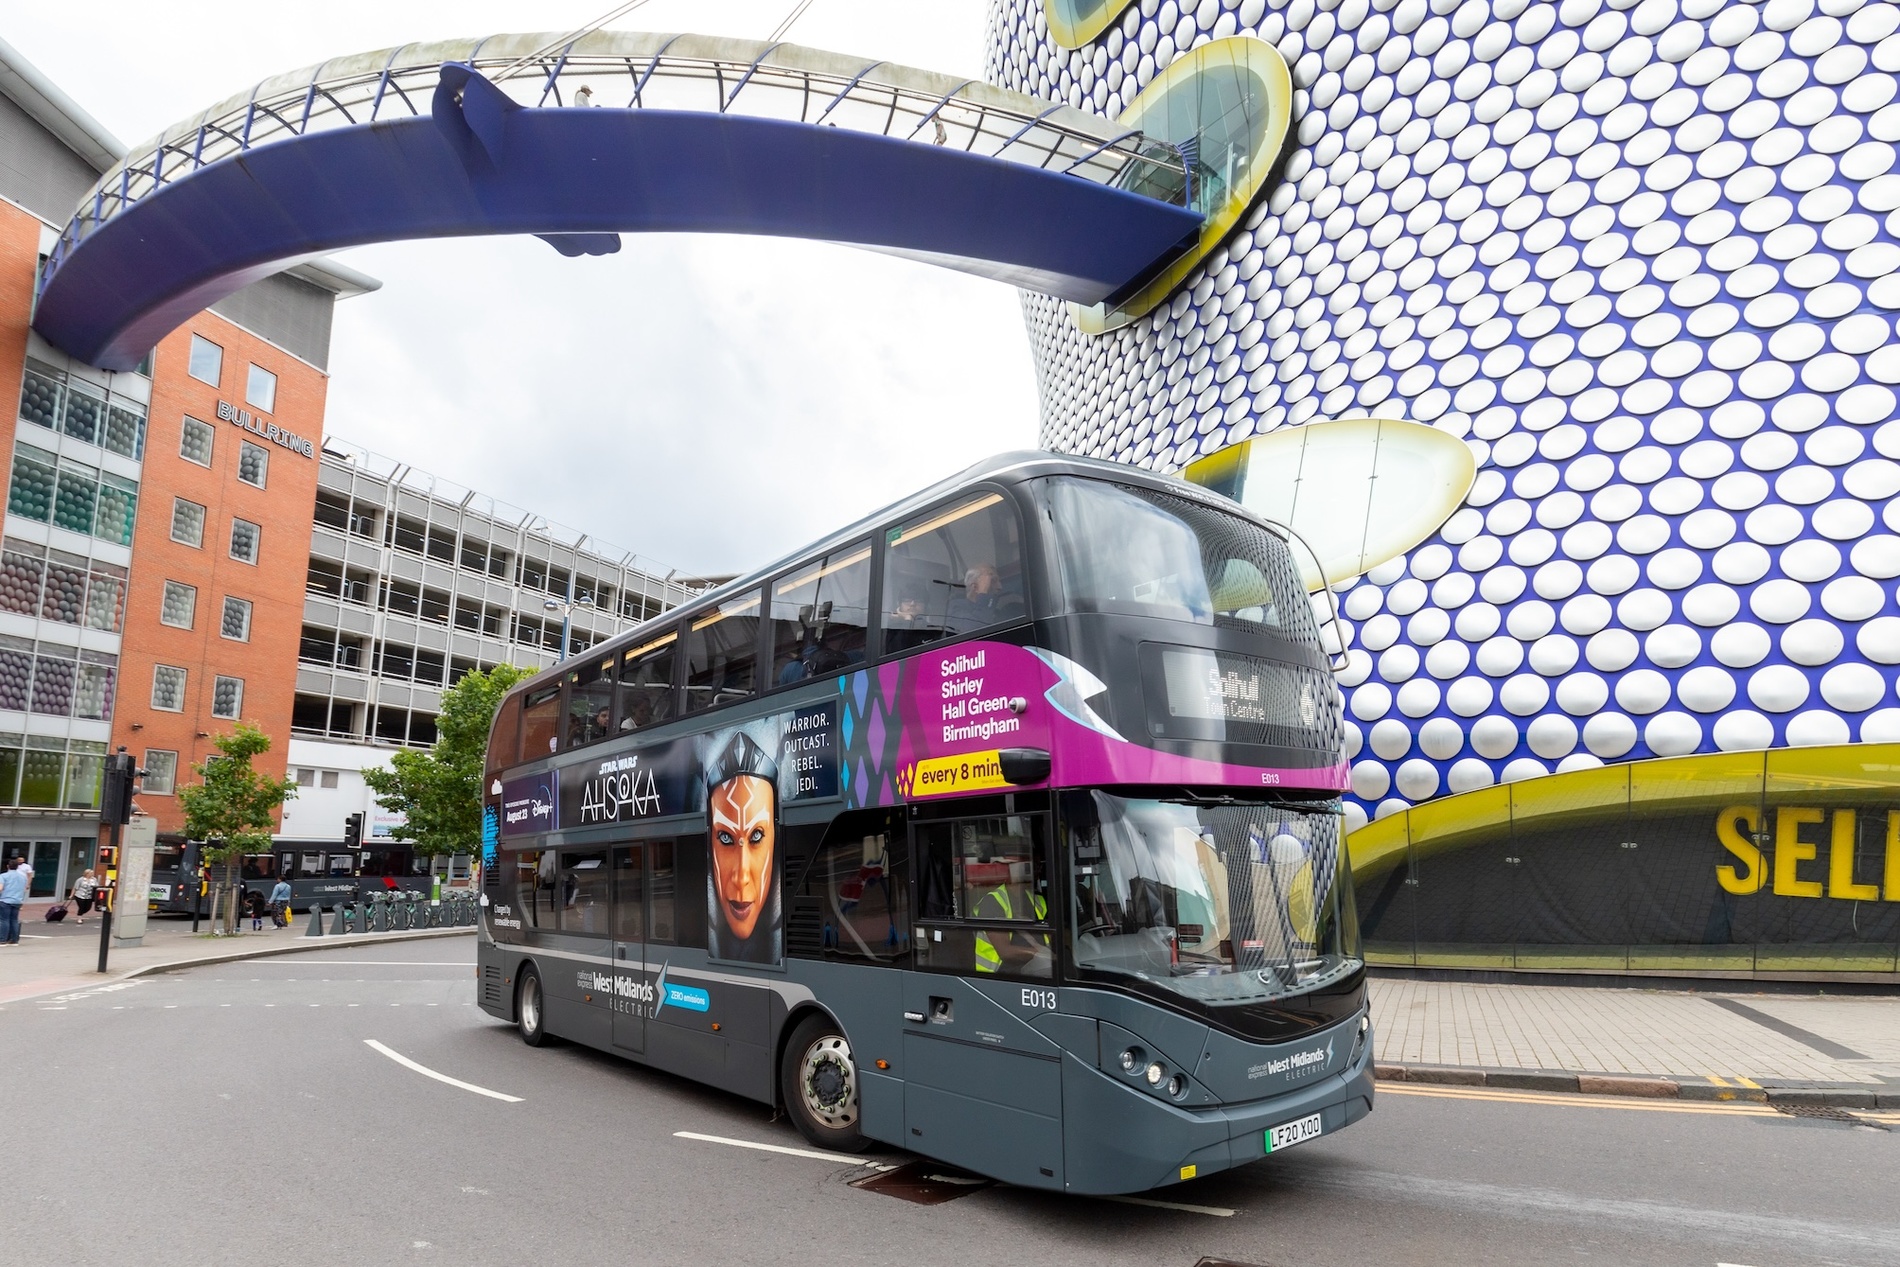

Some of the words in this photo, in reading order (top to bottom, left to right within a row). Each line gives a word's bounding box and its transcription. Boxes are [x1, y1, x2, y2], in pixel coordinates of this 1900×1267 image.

[217, 399, 314, 459] BULLRING
[941, 650, 985, 677] Solihull
[941, 677, 984, 698] Shirley
[1208, 668, 1259, 701] Solihull
[942, 700, 966, 720] Hall
[968, 696, 1008, 715] Green
[1203, 697, 1230, 716] Town
[1231, 700, 1265, 720] Centre
[783, 713, 830, 734] WARRIOR.
[943, 717, 1020, 742] Birmingham
[784, 733, 830, 754] OUTCAST.
[599, 760, 618, 775] STAR
[618, 755, 638, 771] WARS
[791, 756, 823, 772] REBEL.
[922, 768, 958, 785] every
[961, 763, 969, 780] 8
[973, 758, 1005, 778] min
[795, 777, 819, 795] JEDI.
[1261, 773, 1280, 784] E013
[580, 768, 660, 823] AHSOKA
[506, 810, 521, 823] August
[521, 808, 528, 819] 23
[577, 970, 593, 981] national
[577, 979, 593, 990] express
[592, 972, 614, 994] West
[614, 975, 654, 1003] Midlands
[671, 990, 684, 1001] ZERO
[683, 993, 706, 1006] emissions
[609, 998, 654, 1019] ELECTRIC
[1021, 988, 1056, 1010] E013
[1247, 1063, 1268, 1073] national
[1268, 1058, 1290, 1075] West
[1290, 1048, 1325, 1069] Midlands
[1286, 1062, 1325, 1081] ELECTRIC
[1247, 1070, 1268, 1080] express
[1271, 1125, 1299, 1148] LF20
